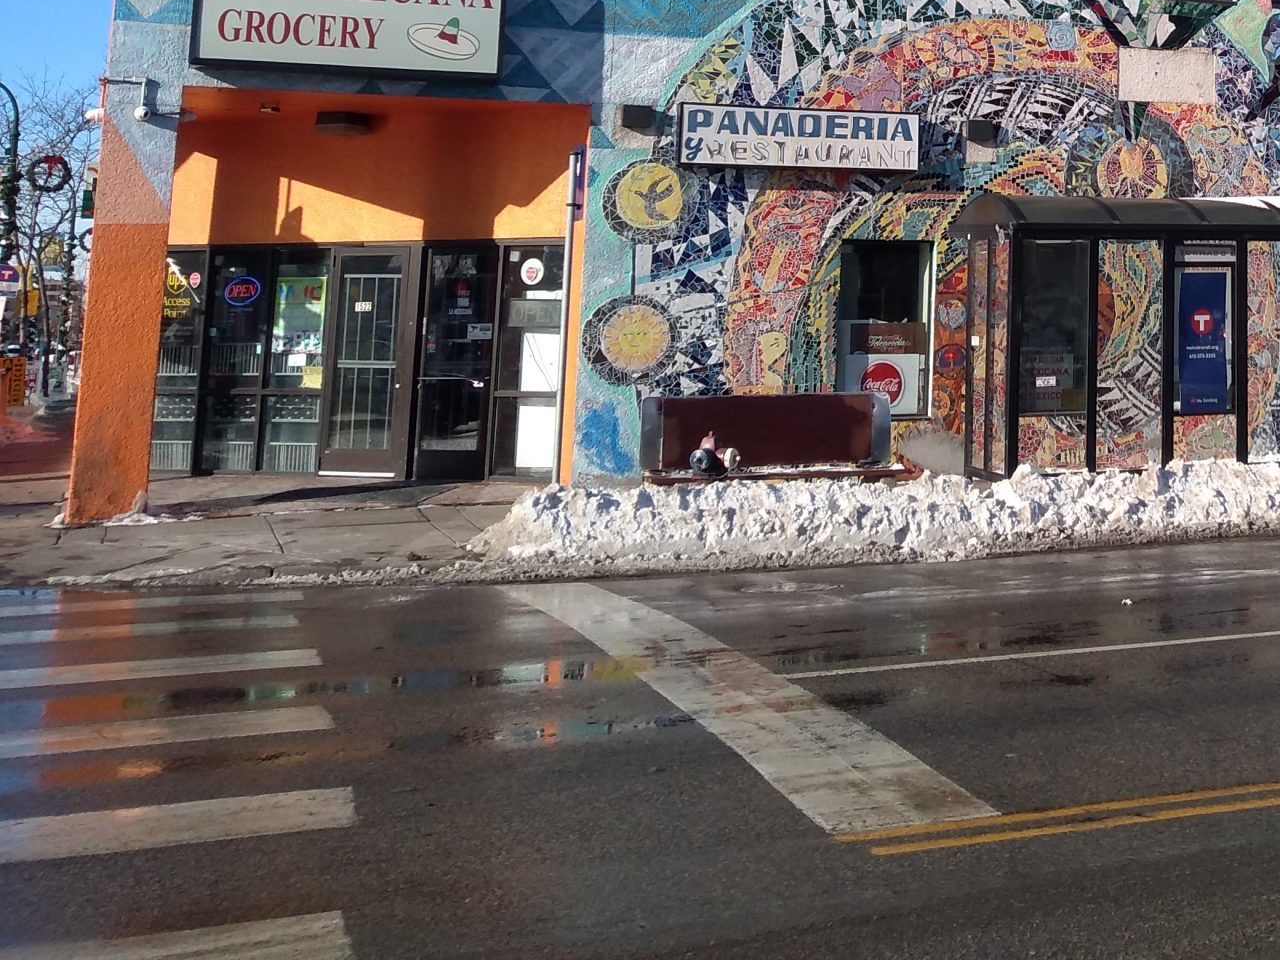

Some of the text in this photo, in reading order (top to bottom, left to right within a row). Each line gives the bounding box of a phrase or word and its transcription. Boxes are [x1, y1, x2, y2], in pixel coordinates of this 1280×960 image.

[217, 8, 385, 51] GROCERY
[686, 108, 914, 141] PANADERIA
[706, 140, 917, 168] RESTAURANT
[227, 284, 257, 298] OPEN
[163, 296, 191, 306] Access
[512, 304, 560, 322] OPEN
[1194, 314, 1210, 332] T
